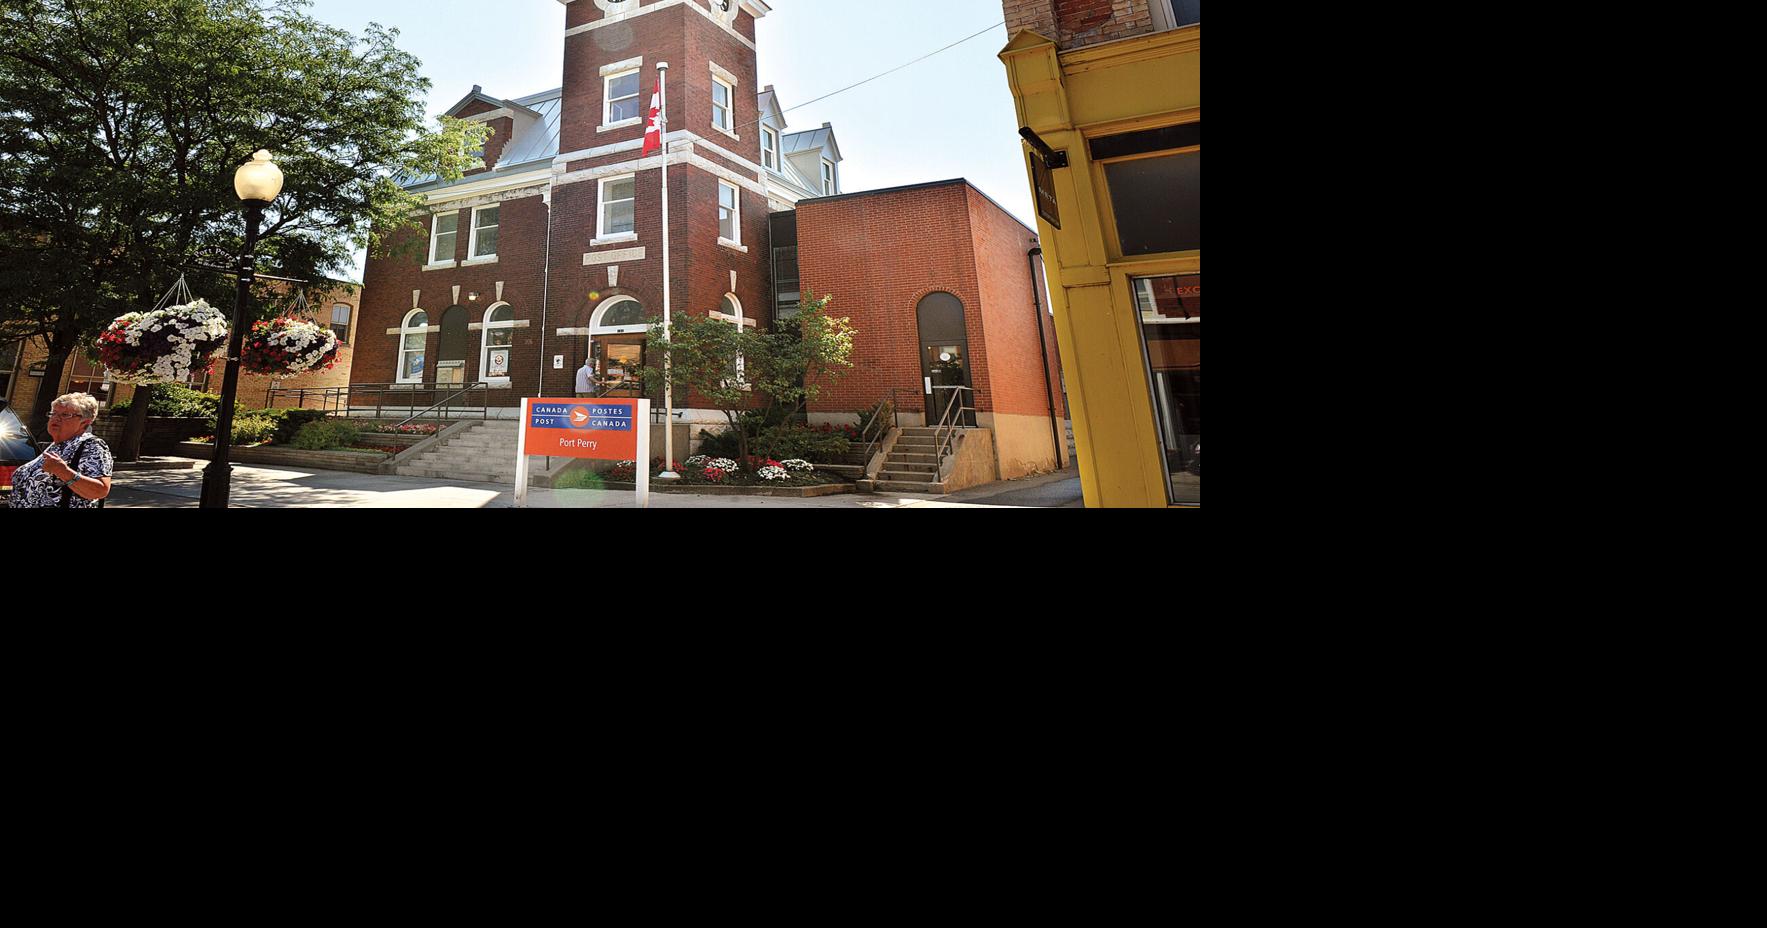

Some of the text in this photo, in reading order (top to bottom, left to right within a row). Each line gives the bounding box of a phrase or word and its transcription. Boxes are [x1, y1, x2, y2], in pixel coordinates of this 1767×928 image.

[536, 406, 568, 414] CANADA
[560, 438, 597, 450] Port Perry
